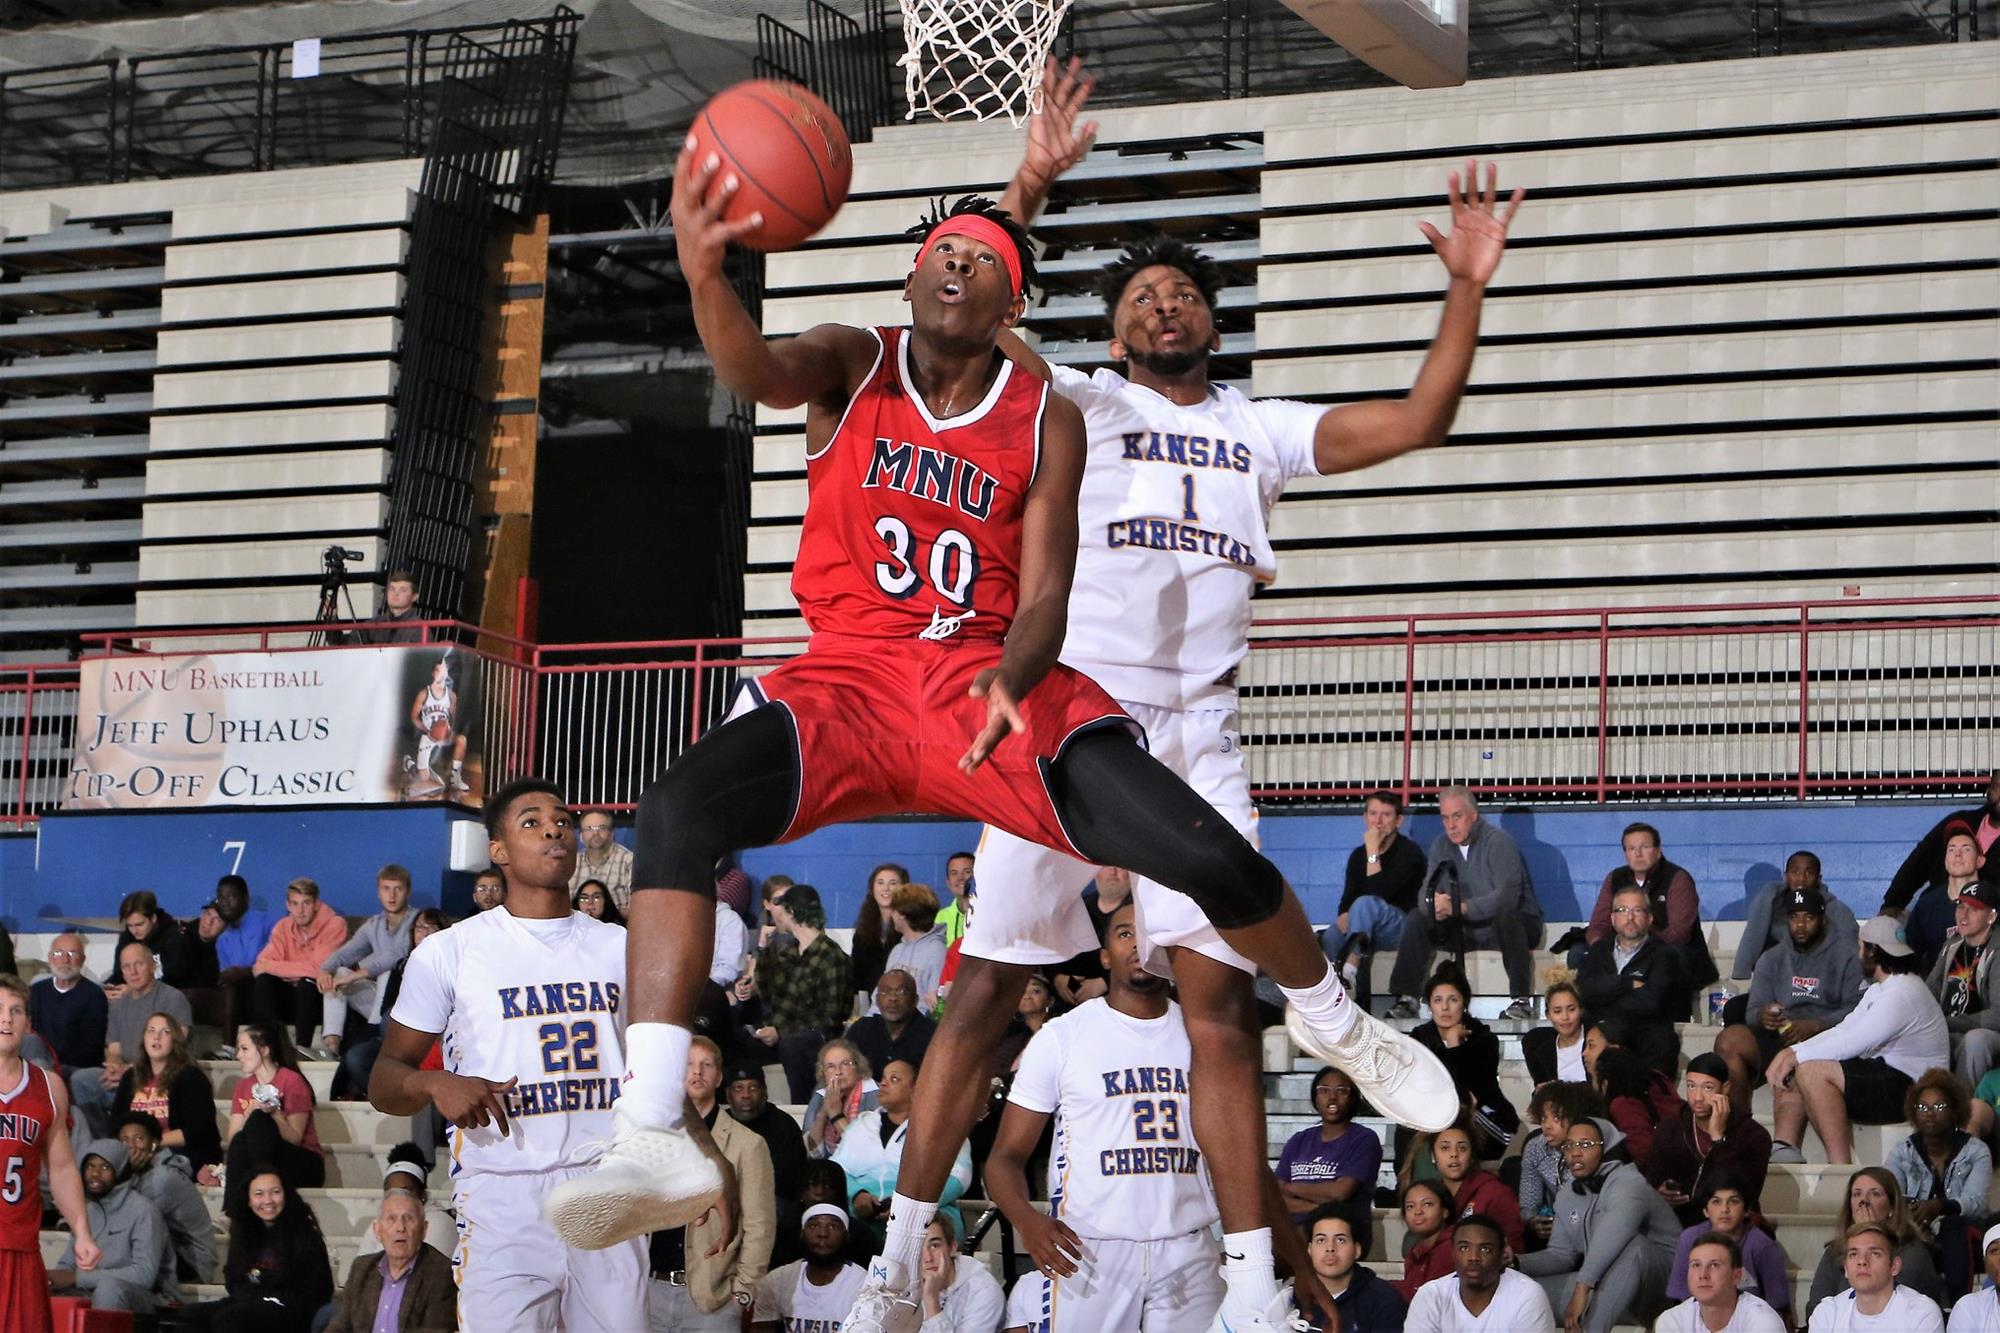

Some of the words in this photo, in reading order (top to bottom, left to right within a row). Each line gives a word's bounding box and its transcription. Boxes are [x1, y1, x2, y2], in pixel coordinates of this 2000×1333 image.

[1121, 432, 1252, 473] KANSAS
[861, 437, 1000, 522] MNU
[1182, 473, 1200, 522] 1
[874, 515, 980, 608] 30
[112, 669, 181, 693] MNU
[190, 668, 324, 690] BASKETBALL
[90, 713, 168, 751] JEFF
[184, 711, 329, 745] UPHAUS
[70, 765, 204, 798] TIP-OFF
[219, 764, 355, 797] CLASSIC
[222, 841, 246, 876] 7
[498, 981, 620, 1019] KANSAS
[538, 1019, 600, 1075] 22
[503, 1078, 622, 1118] CHRISTIA
[1102, 1067, 1188, 1098] KANSA
[0, 1113, 40, 1146] NU
[1133, 1100, 1181, 1142] 23
[2, 1156, 24, 1204] 5
